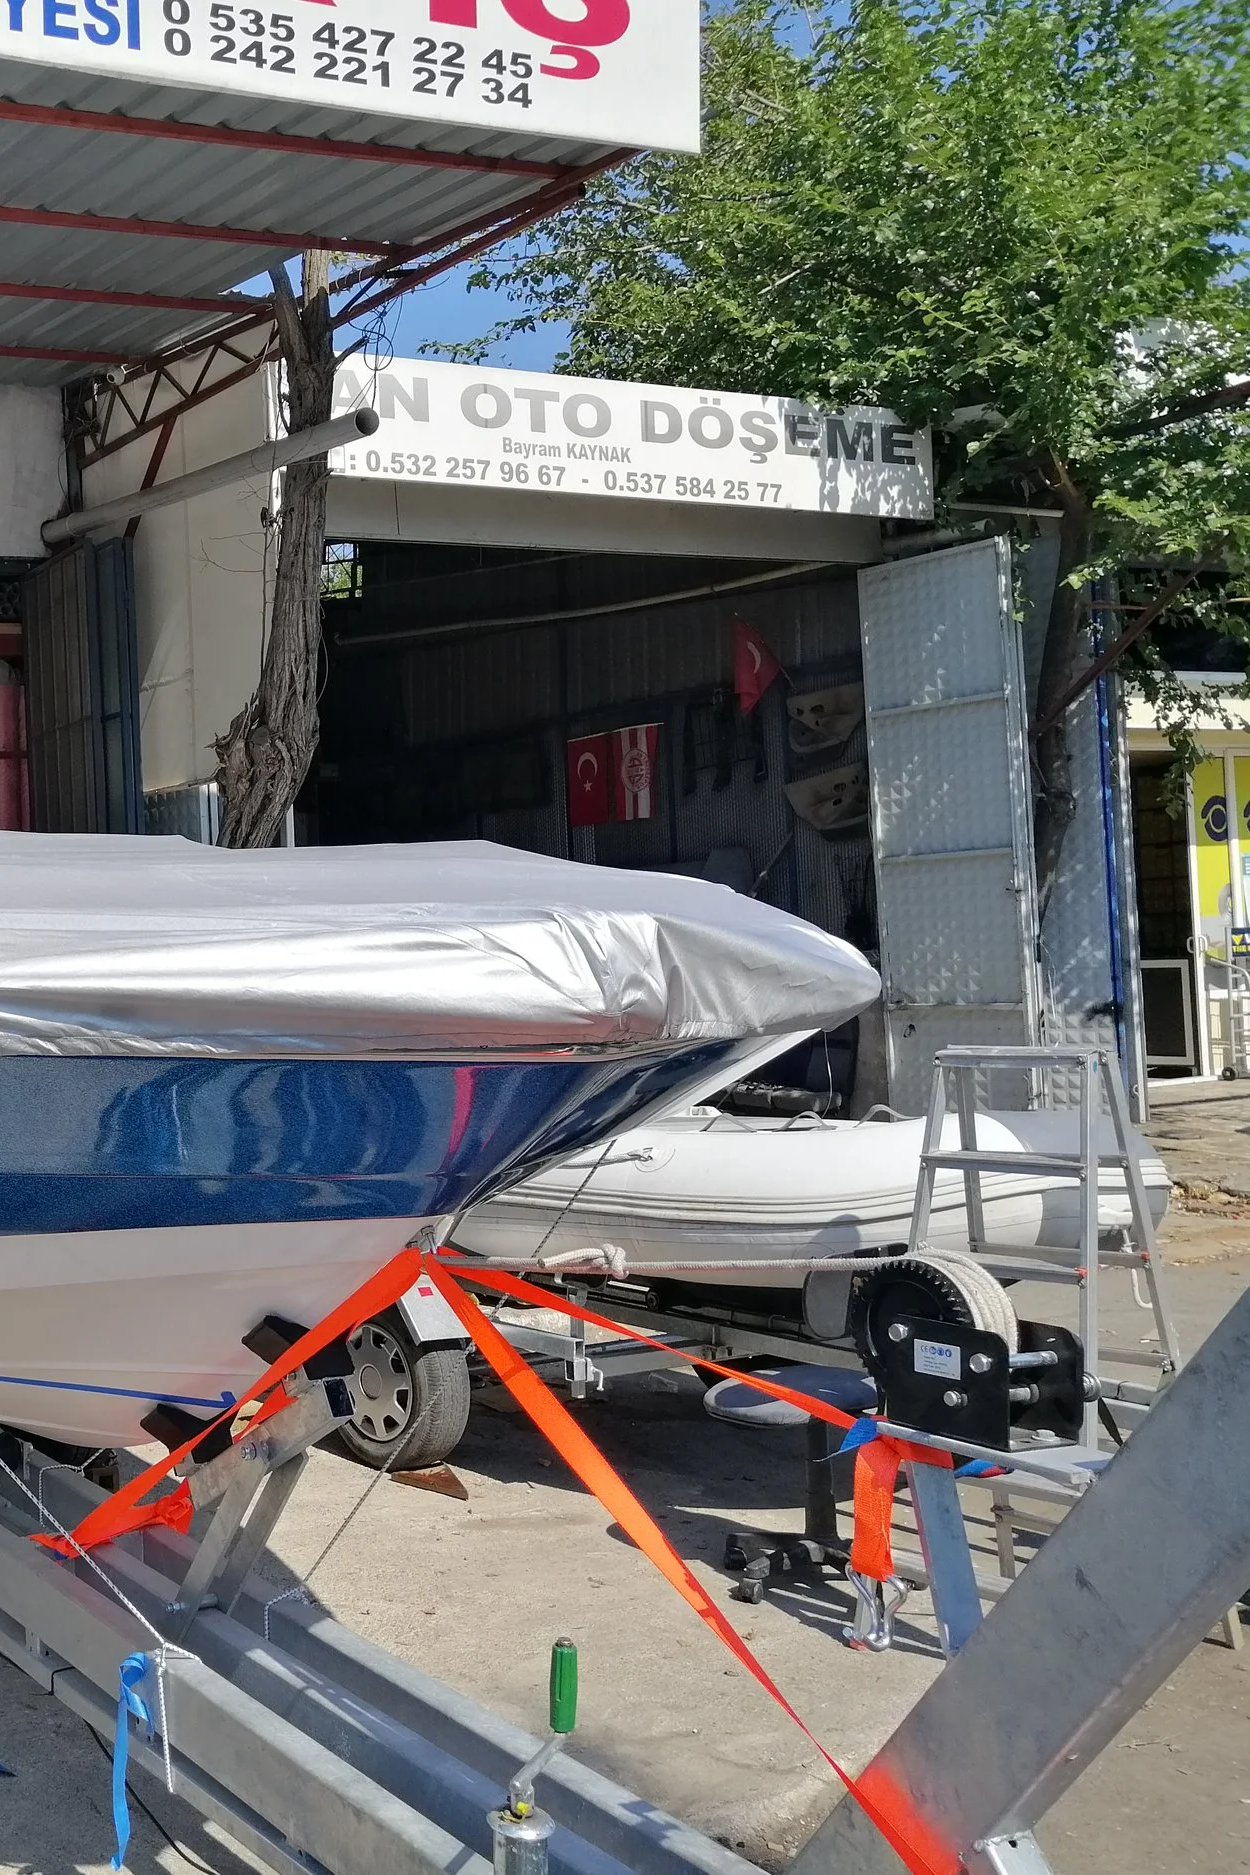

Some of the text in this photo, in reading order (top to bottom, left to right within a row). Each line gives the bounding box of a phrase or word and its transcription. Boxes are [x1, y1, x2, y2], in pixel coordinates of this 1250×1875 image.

[164, 28, 532, 109] 0 242 221 27 34
[209, 3, 295, 42] 535
[312, 22, 395, 57] 427
[412, 36, 465, 69] 22
[481, 49, 533, 79] 45
[461, 383, 612, 438] OTO
[641, 396, 916, 465] DÖŞEME
[502, 437, 632, 464] Bayram KAYNAK
[366, 450, 437, 477] 0.532
[446, 456, 491, 480] 257
[500, 461, 530, 484] 96
[537, 465, 566, 487] 67
[604, 470, 667, 495] 0.537
[675, 475, 716, 499] 584
[723, 480, 750, 501] 25
[756, 482, 782, 503] 77
